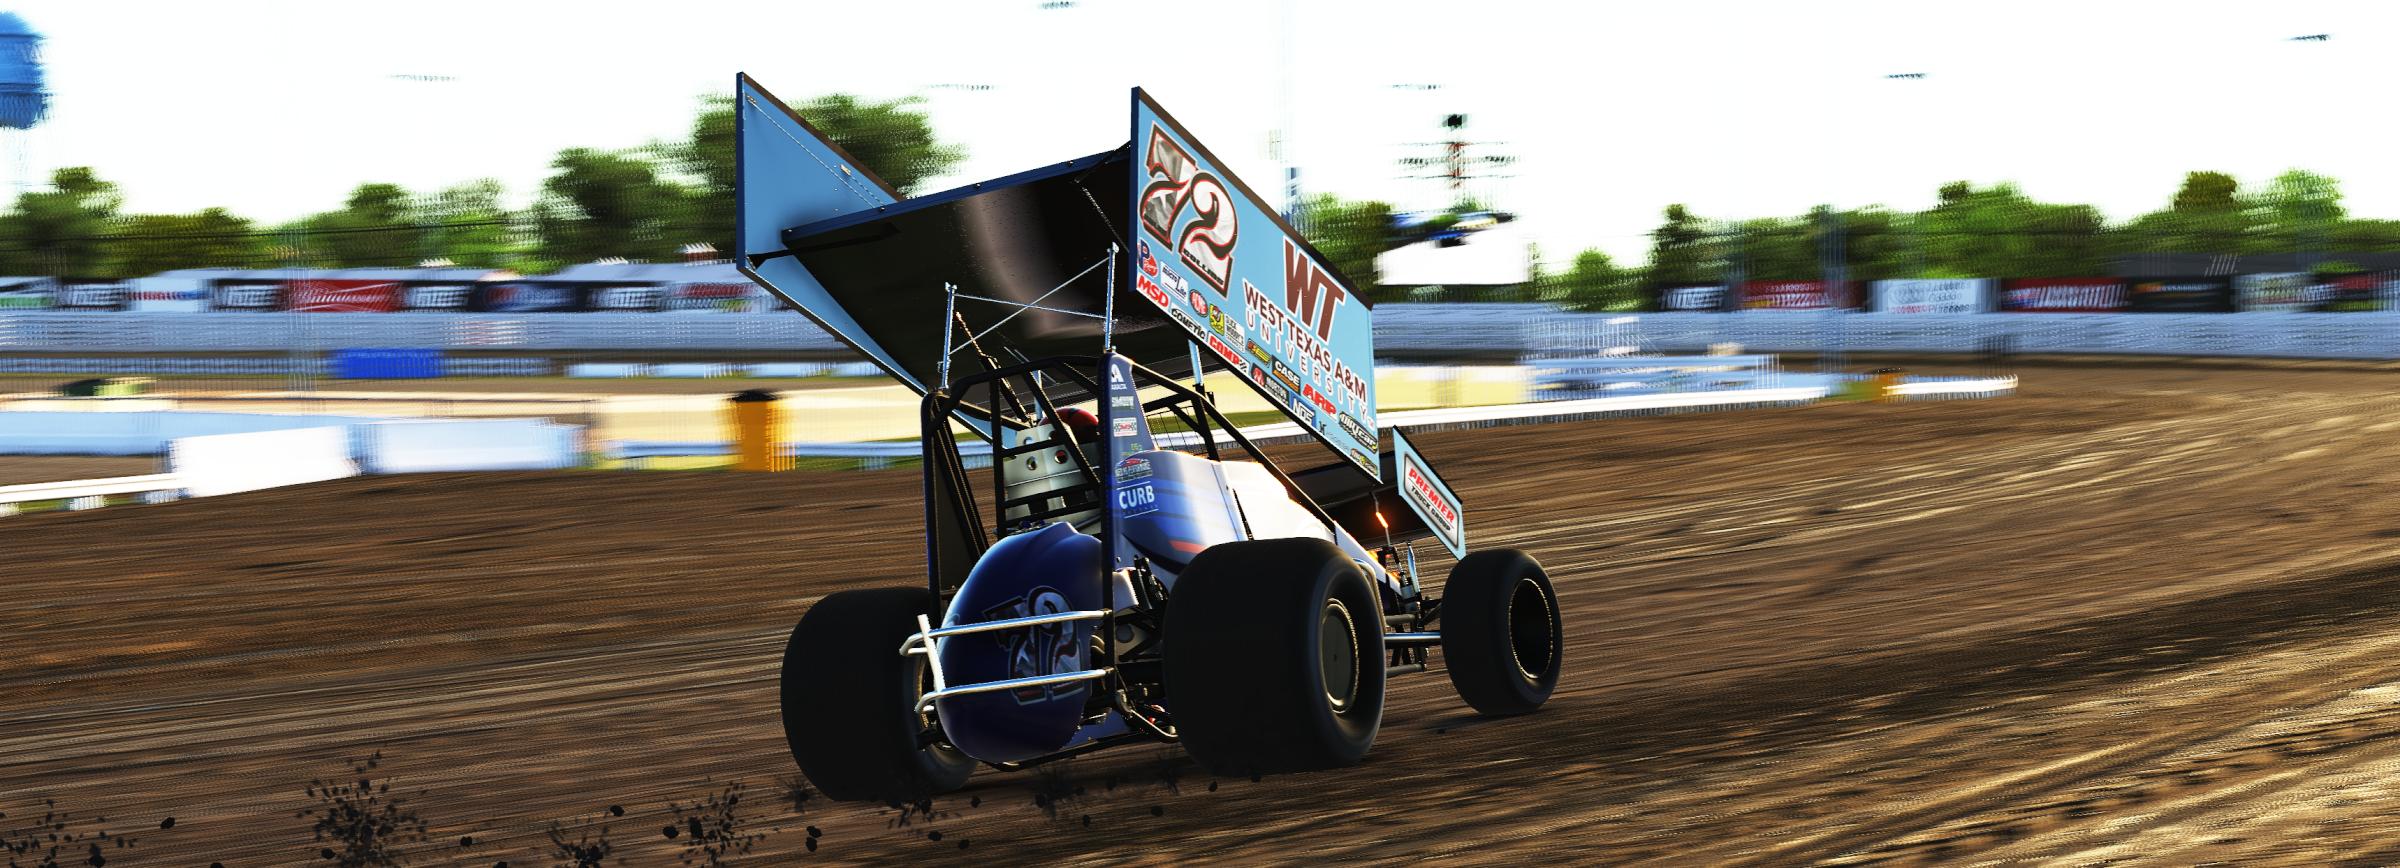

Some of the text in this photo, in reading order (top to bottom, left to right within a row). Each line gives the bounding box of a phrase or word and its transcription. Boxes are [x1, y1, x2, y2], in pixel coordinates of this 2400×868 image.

[1139, 122, 1237, 299] 72
[1138, 275, 1169, 307] MSD
[1283, 236, 1346, 344] WT
[1171, 308, 1206, 340] COMETIC
[1209, 335, 1240, 365] COMP
[1244, 280, 1284, 333] WEST
[1287, 318, 1331, 373] TEXAS
[1334, 360, 1366, 403] A&M
[1274, 360, 1300, 387] CASE
[1302, 383, 1337, 416] ARP
[1119, 485, 1155, 510] CURB
[1408, 467, 1455, 523] PREMIER
[1411, 485, 1451, 531] TRUCK GROUP
